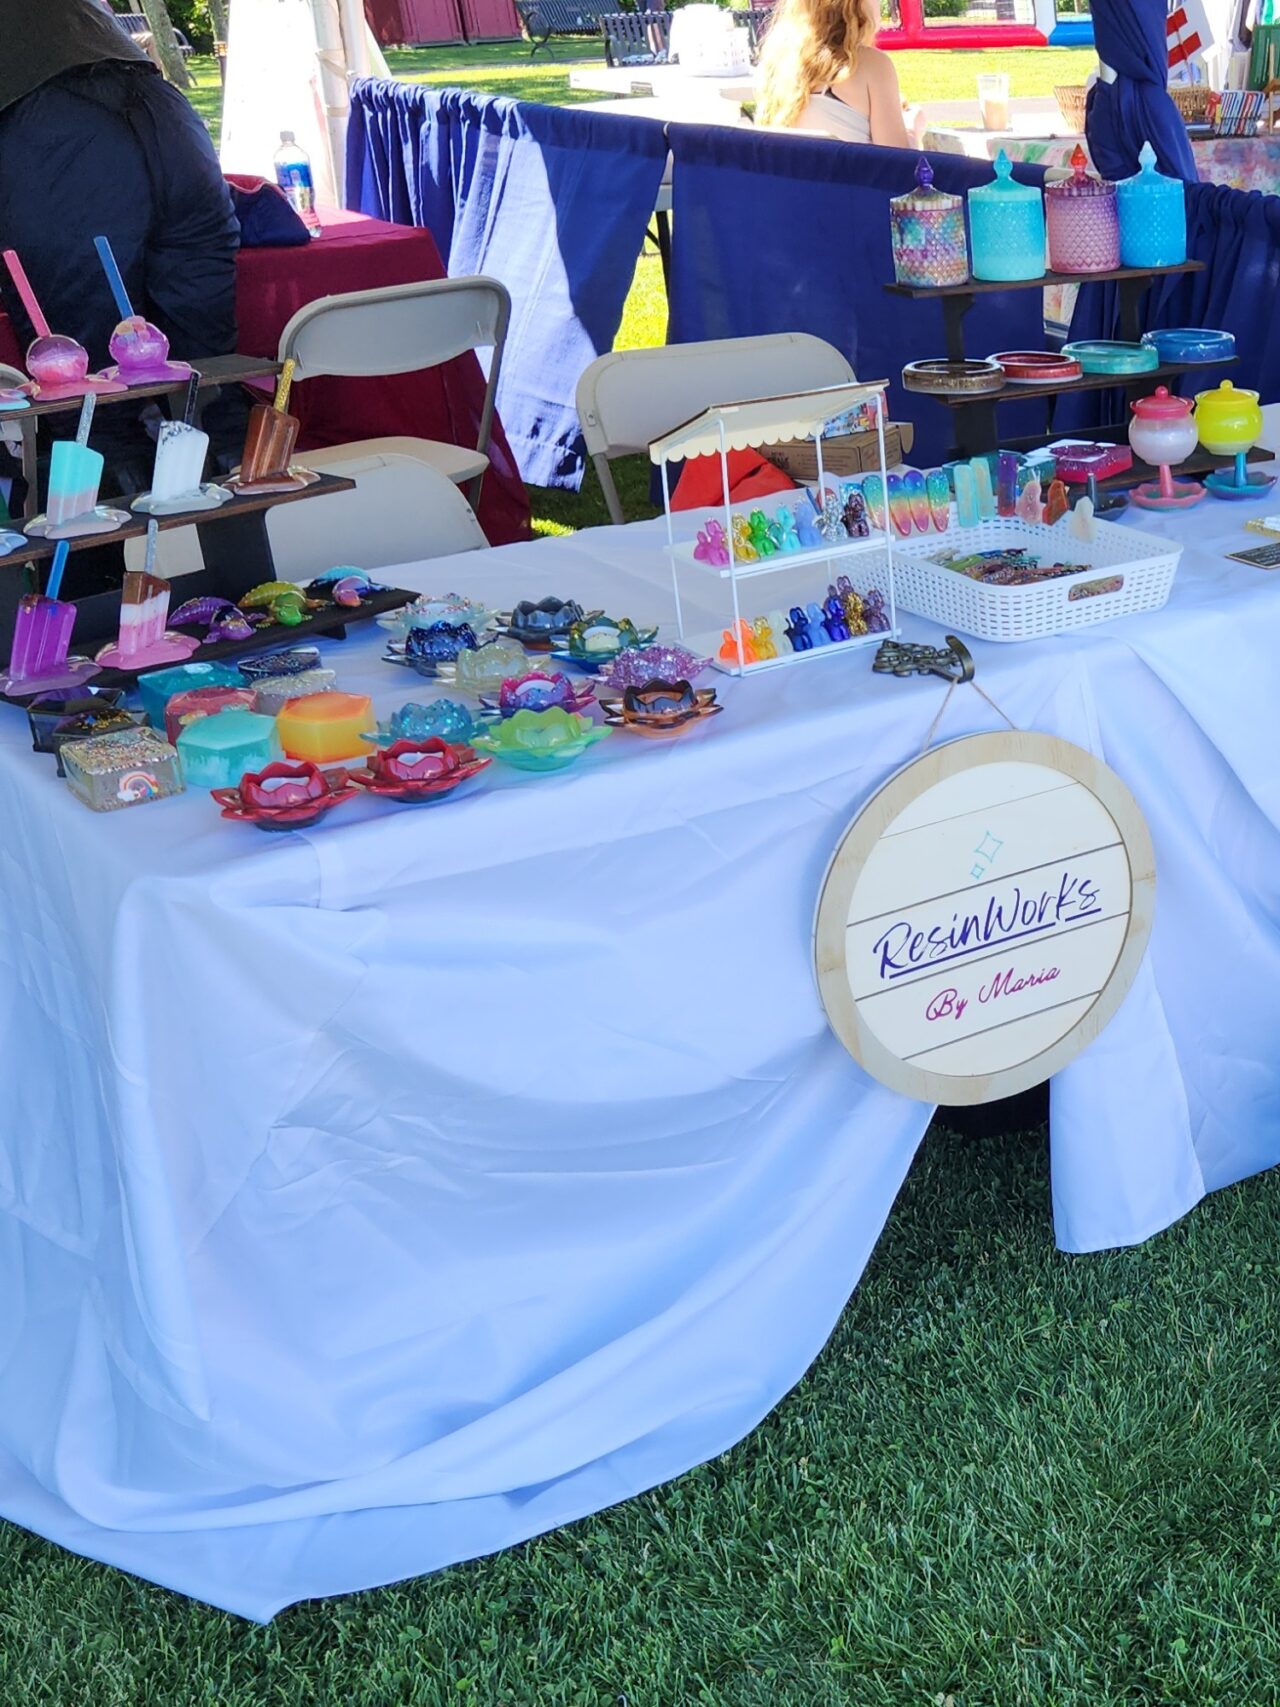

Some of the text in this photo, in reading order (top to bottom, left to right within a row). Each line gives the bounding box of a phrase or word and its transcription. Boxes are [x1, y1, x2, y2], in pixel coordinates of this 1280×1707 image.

[873, 873, 1101, 979] ResinWorks
[924, 965, 1061, 1021] By Maria
